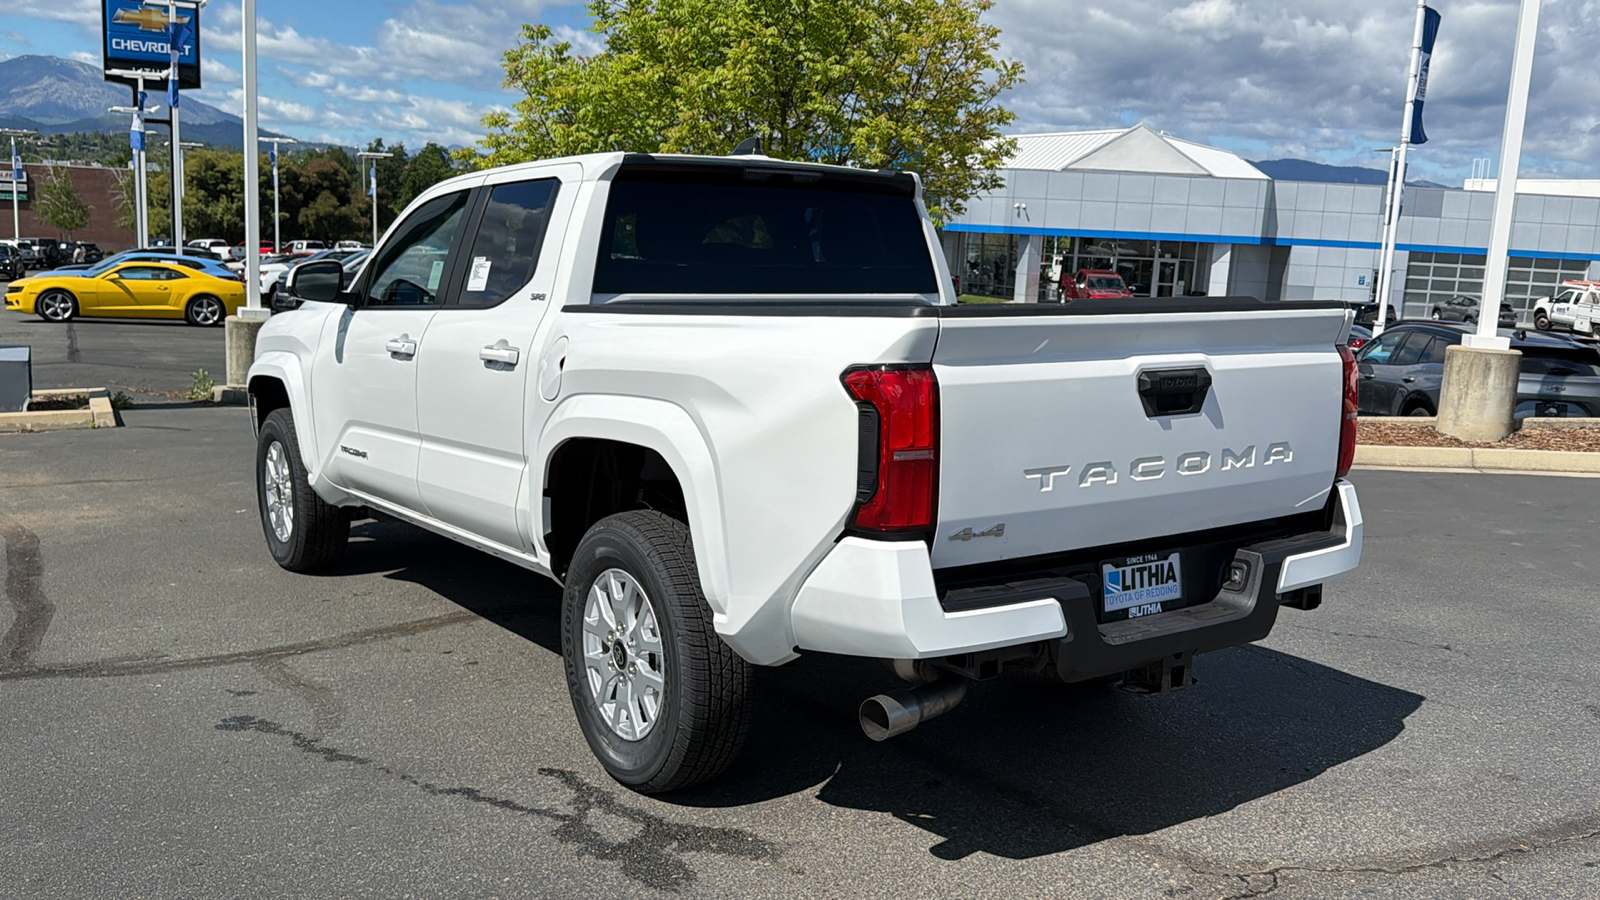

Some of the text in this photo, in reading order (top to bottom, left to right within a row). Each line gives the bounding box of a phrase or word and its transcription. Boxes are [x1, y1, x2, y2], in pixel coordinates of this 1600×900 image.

[112, 38, 191, 55] CHEVROLT
[1023, 441, 1293, 492] TACOMA
[1126, 556, 1143, 564] SINCE
[1121, 562, 1177, 591] LITHIA
[1105, 585, 1177, 605] TOYOTA OF REDDING
[1136, 602, 1161, 616] LITHIA
